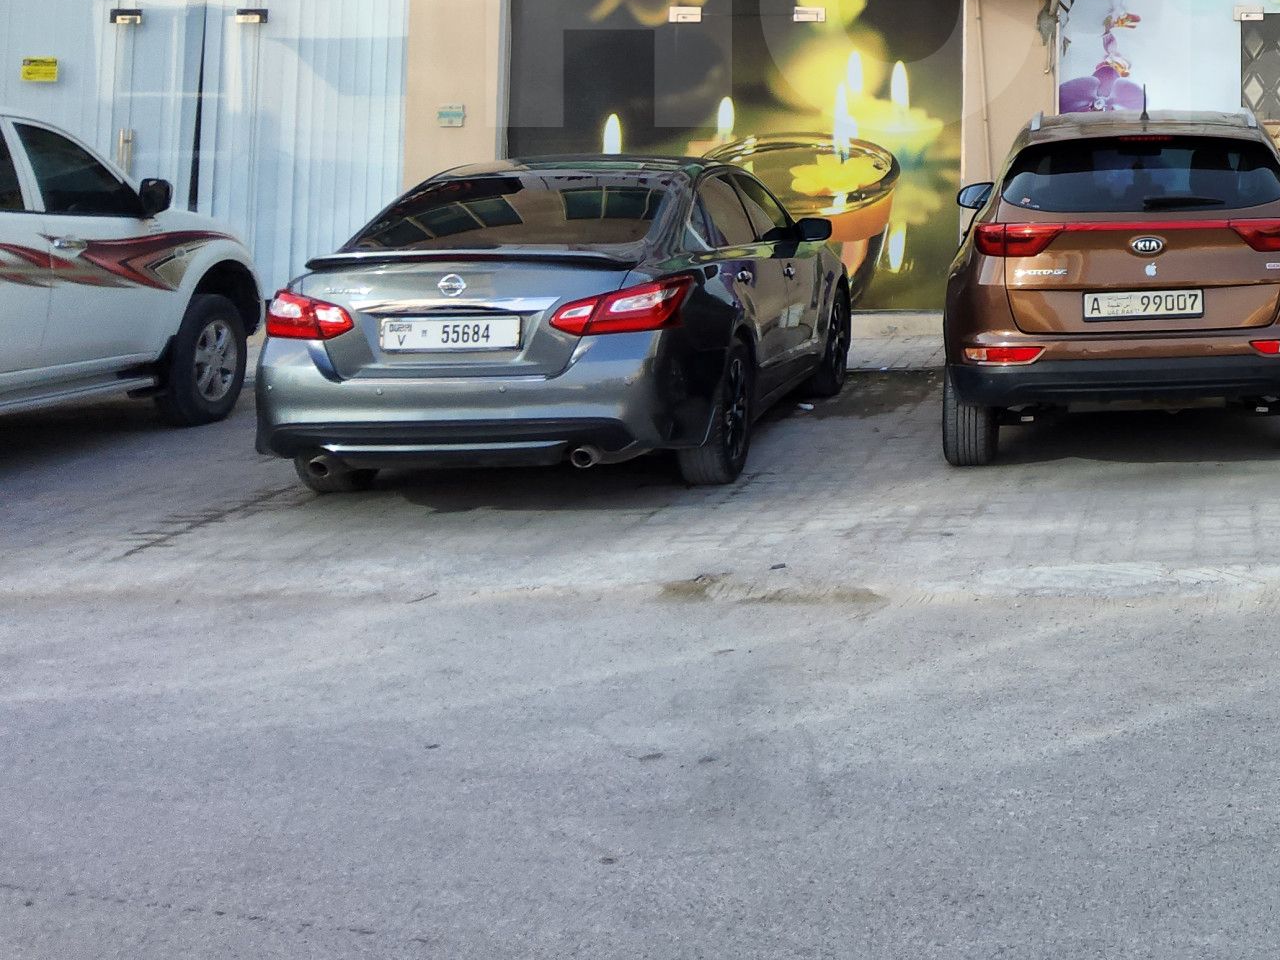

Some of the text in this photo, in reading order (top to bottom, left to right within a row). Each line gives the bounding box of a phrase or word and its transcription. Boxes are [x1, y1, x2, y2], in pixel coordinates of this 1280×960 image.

[1136, 240, 1158, 251] KIA
[1090, 293, 1199, 315] A 99007
[397, 334, 407, 347] V
[441, 324, 491, 344] 55684
